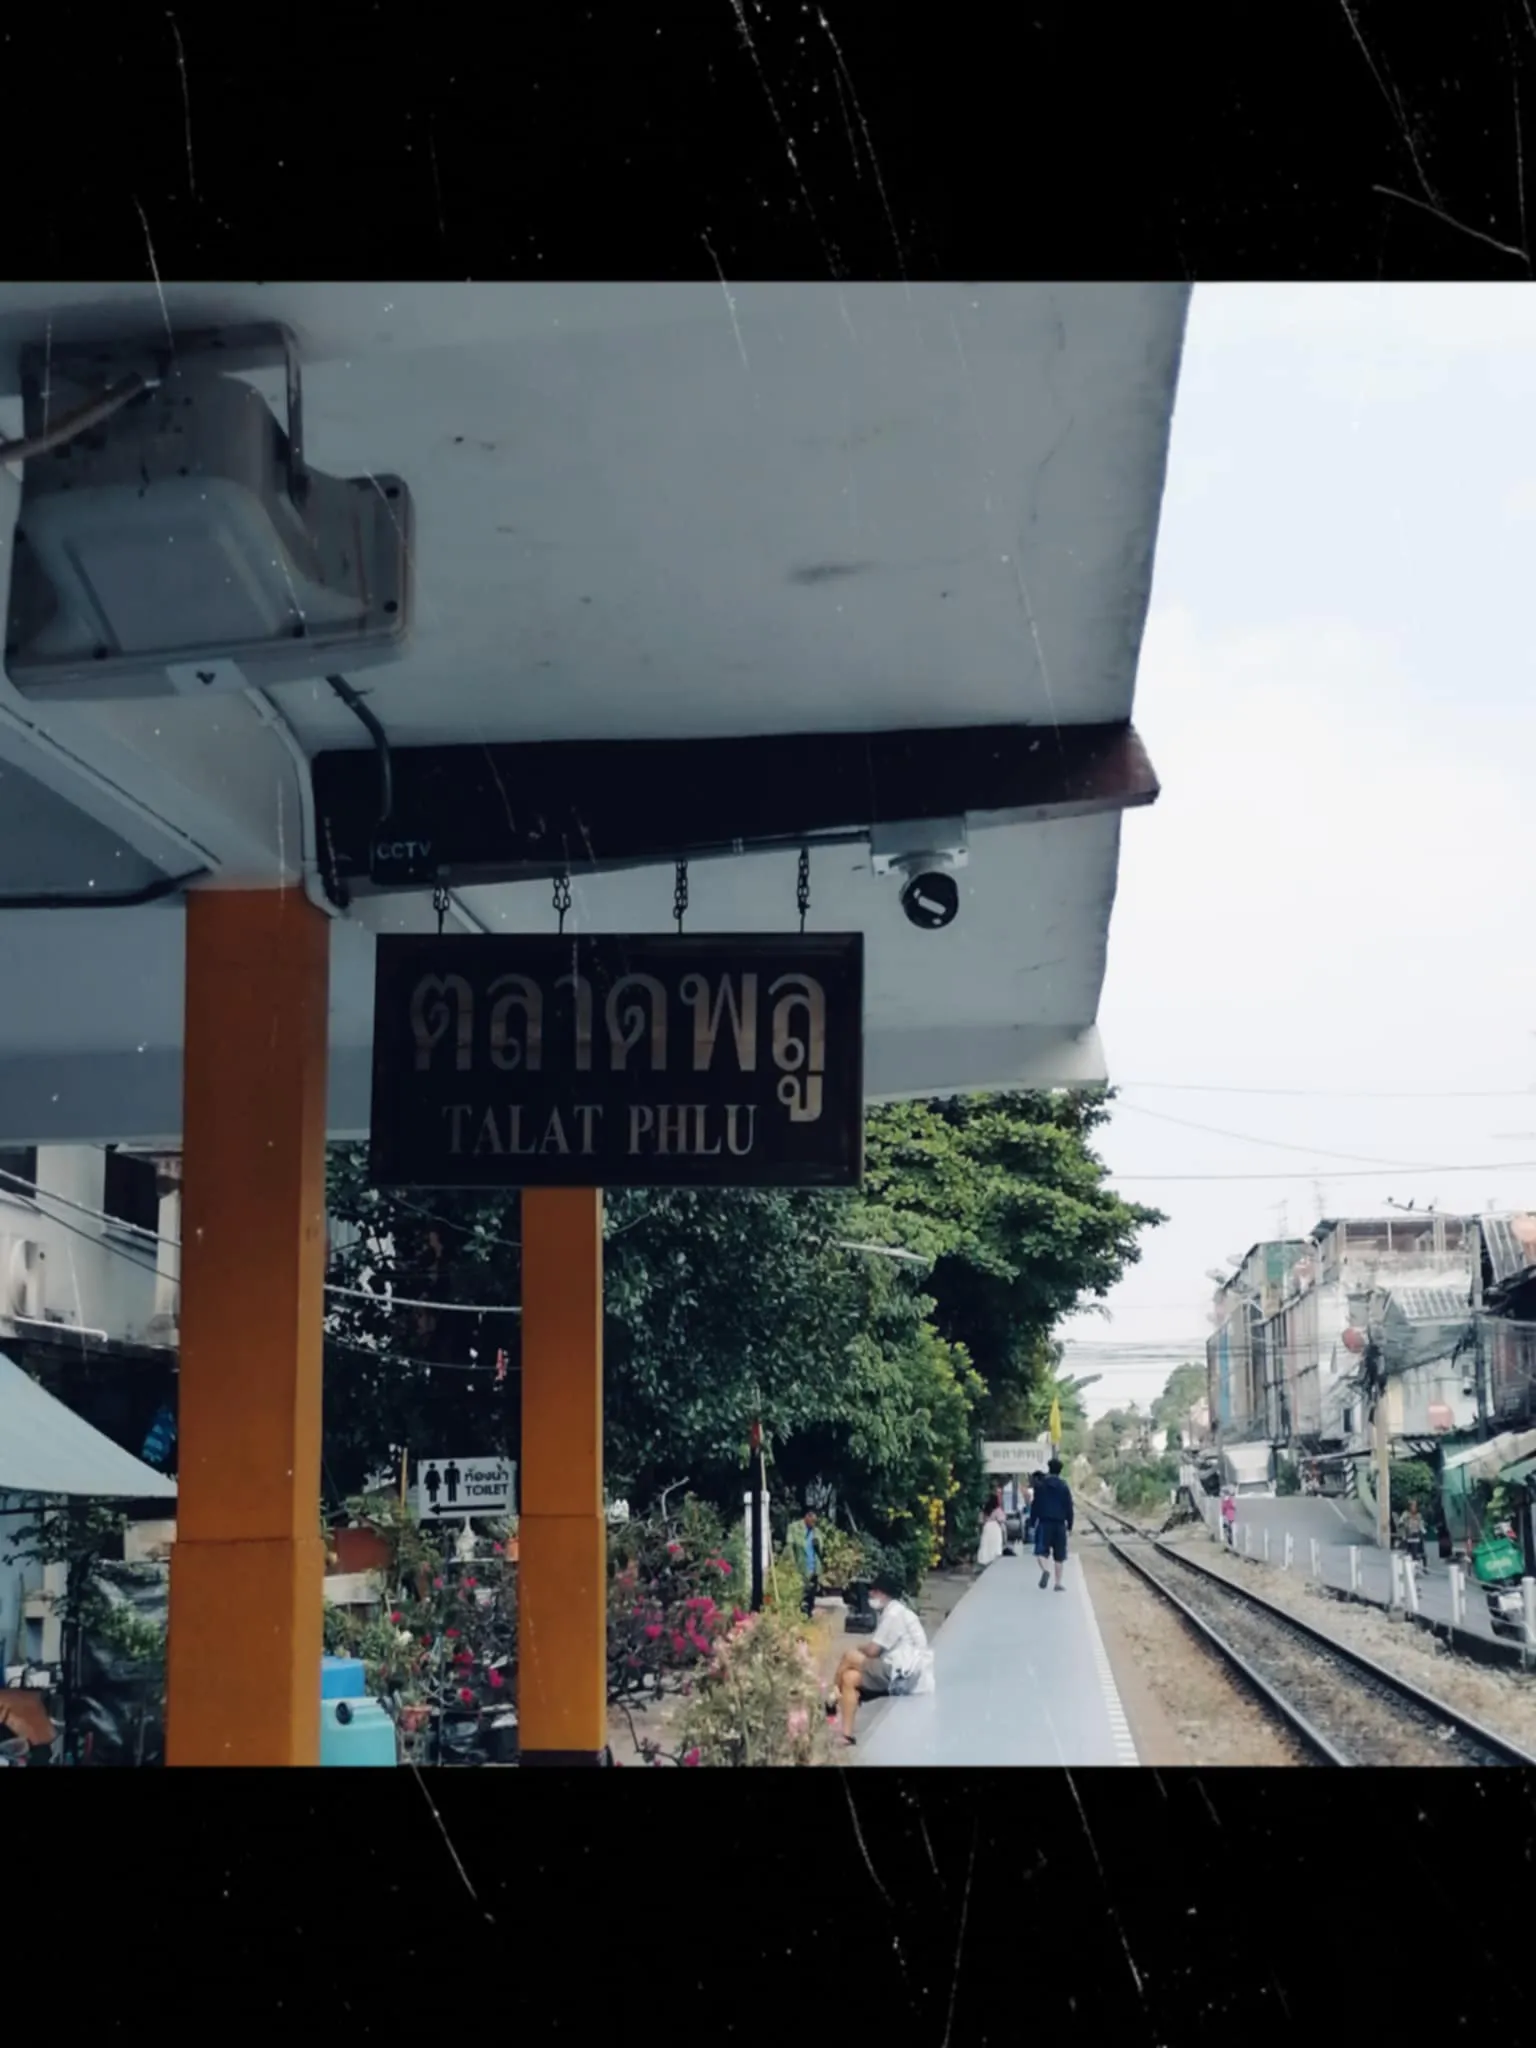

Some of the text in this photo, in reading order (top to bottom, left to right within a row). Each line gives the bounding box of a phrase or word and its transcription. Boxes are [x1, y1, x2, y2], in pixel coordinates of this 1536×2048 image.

[377, 841, 431, 859] CCTV
[410, 972, 826, 1122] ตลาดพลู
[441, 1104, 760, 1156] TALAT PHLU
[465, 1484, 508, 1497] TOILET
